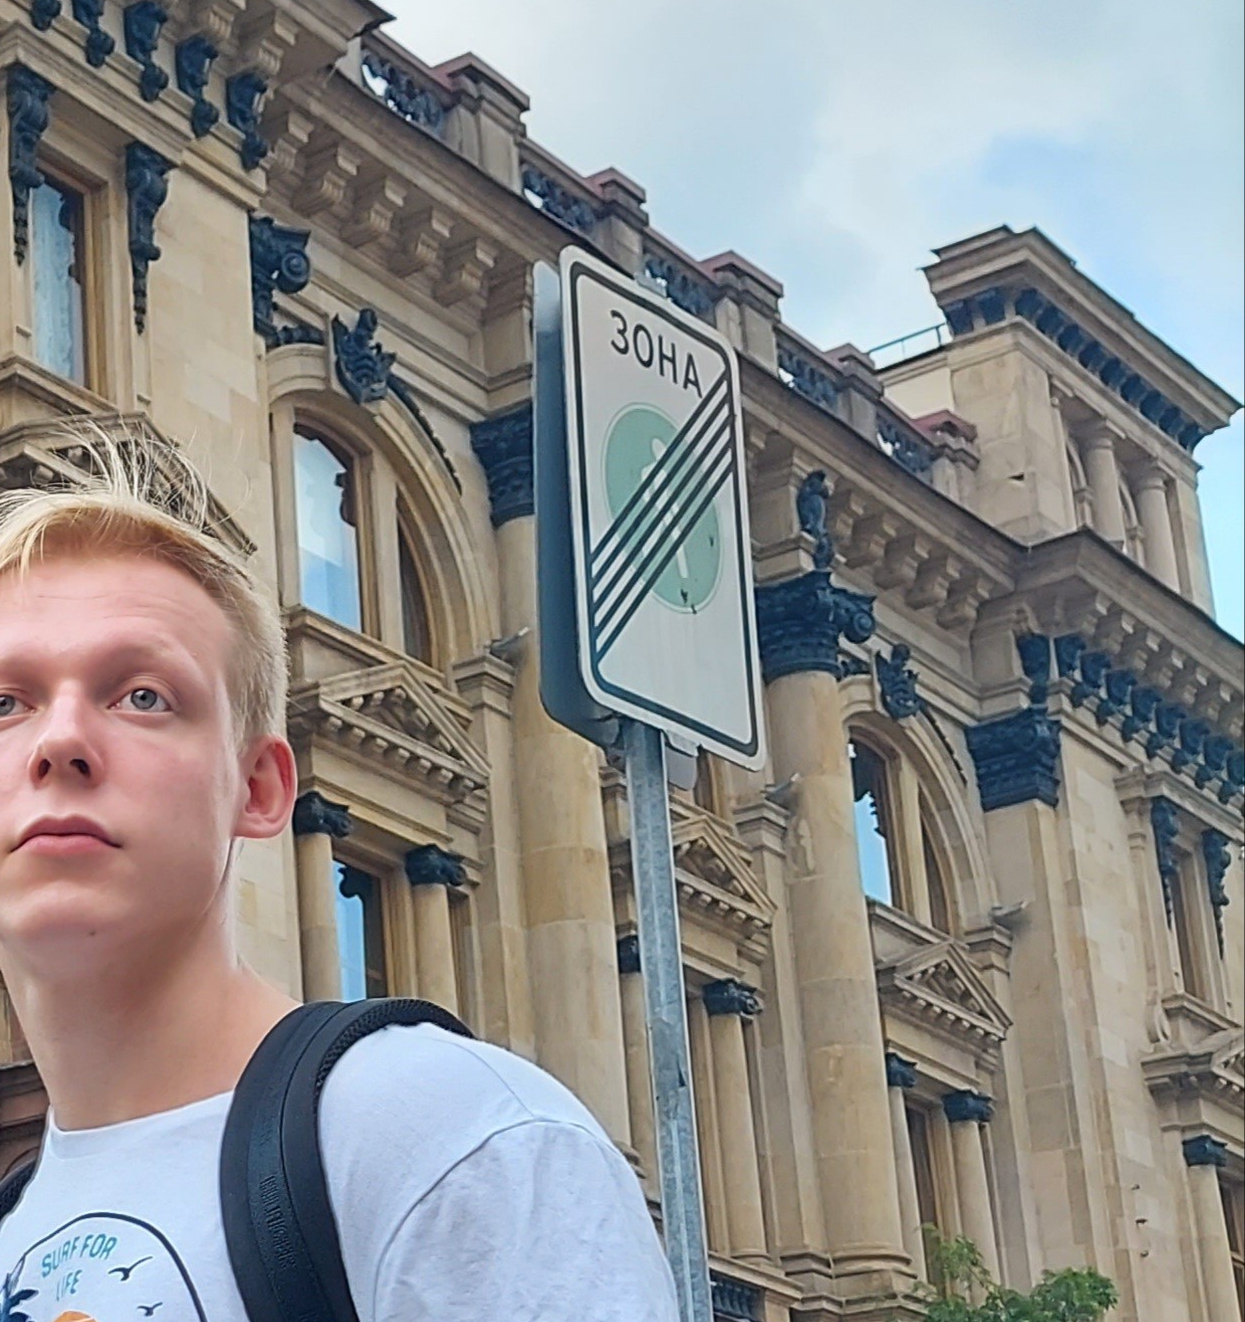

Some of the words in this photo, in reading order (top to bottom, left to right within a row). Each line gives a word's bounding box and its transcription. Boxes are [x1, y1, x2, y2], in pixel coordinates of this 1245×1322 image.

[610, 309, 703, 399] ЗОНА
[41, 1236, 81, 1278] SURF
[80, 1233, 118, 1260] FOR
